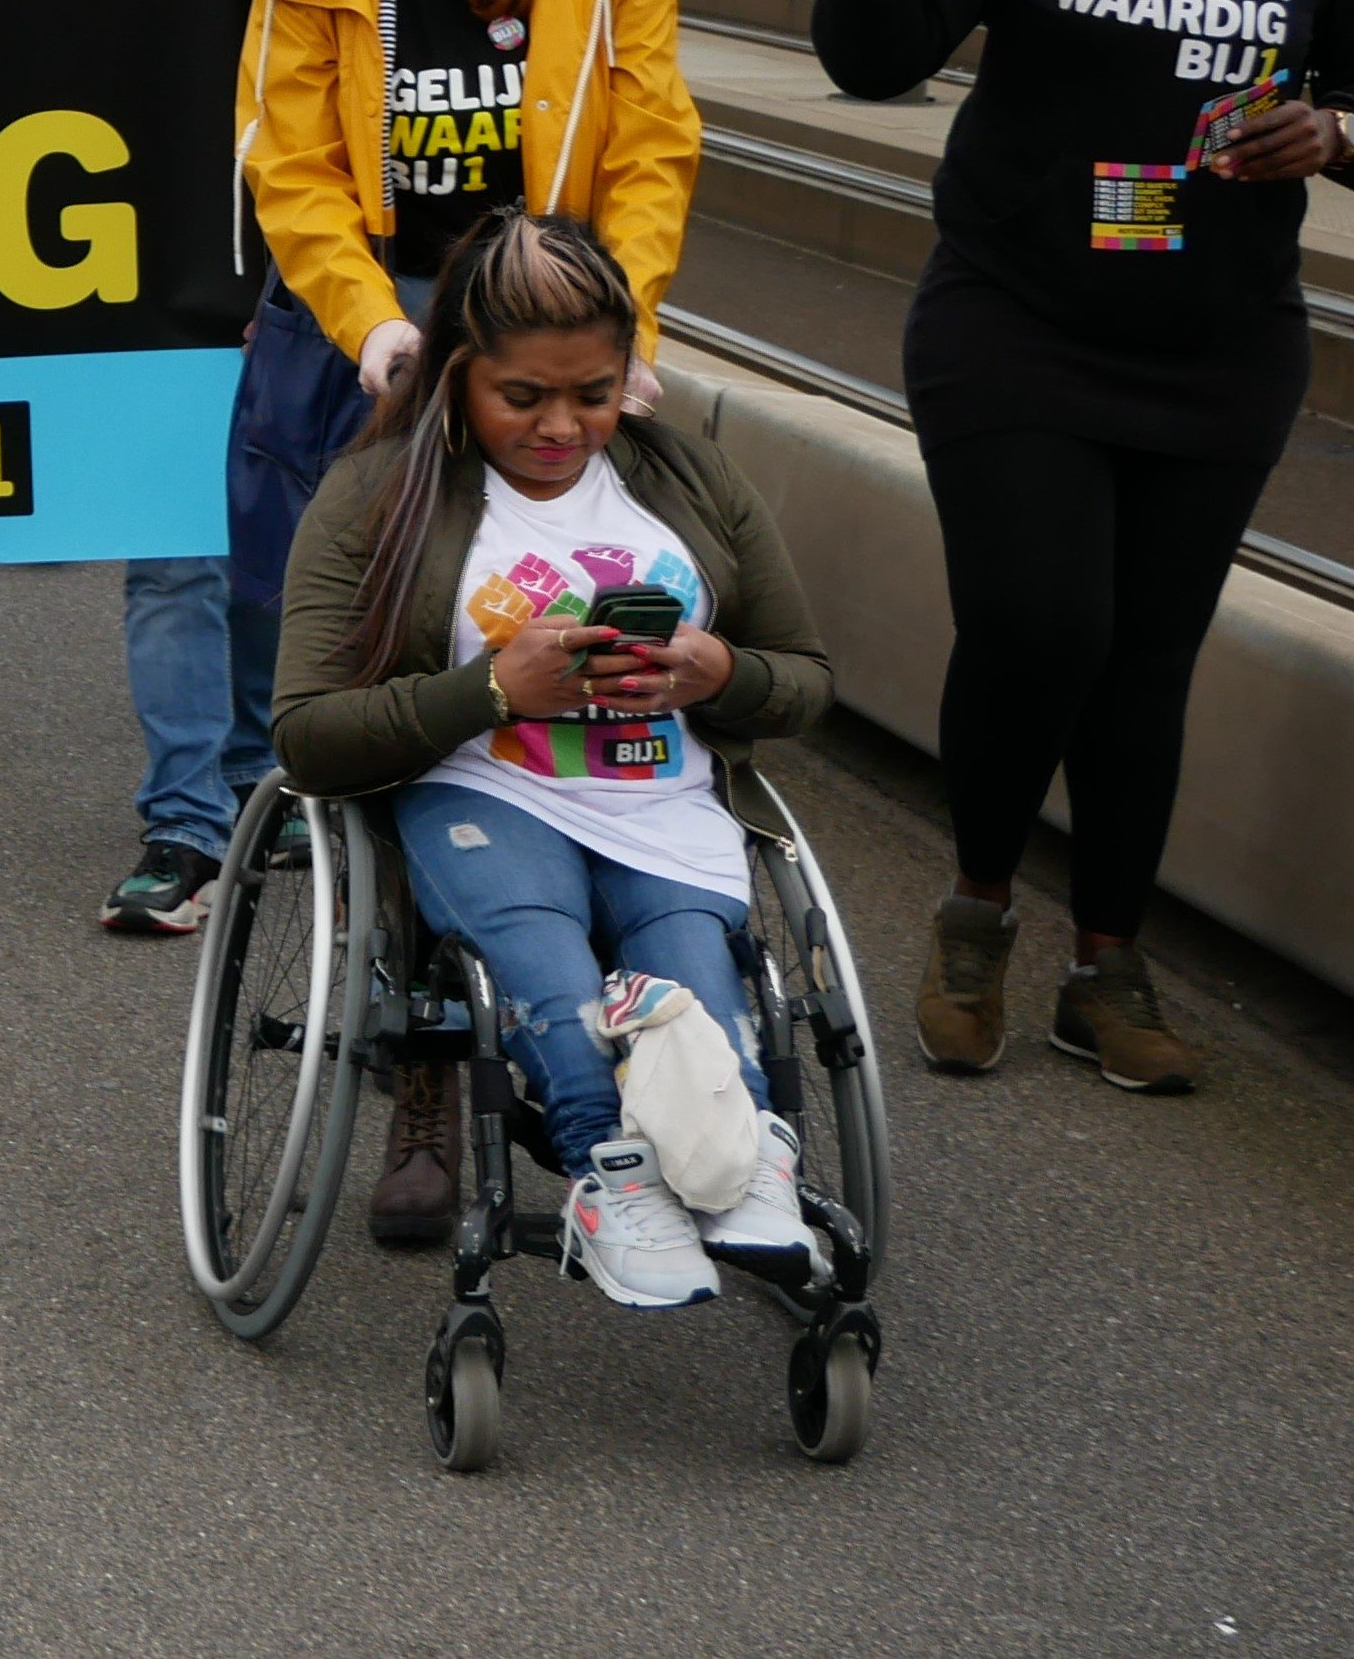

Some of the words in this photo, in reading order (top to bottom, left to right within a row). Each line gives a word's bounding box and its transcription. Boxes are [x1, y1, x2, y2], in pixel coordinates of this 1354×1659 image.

[1175, 39, 1279, 85] BIJ1
[390, 156, 488, 195] BIJ1
[616, 740, 666, 762] BIJ1
